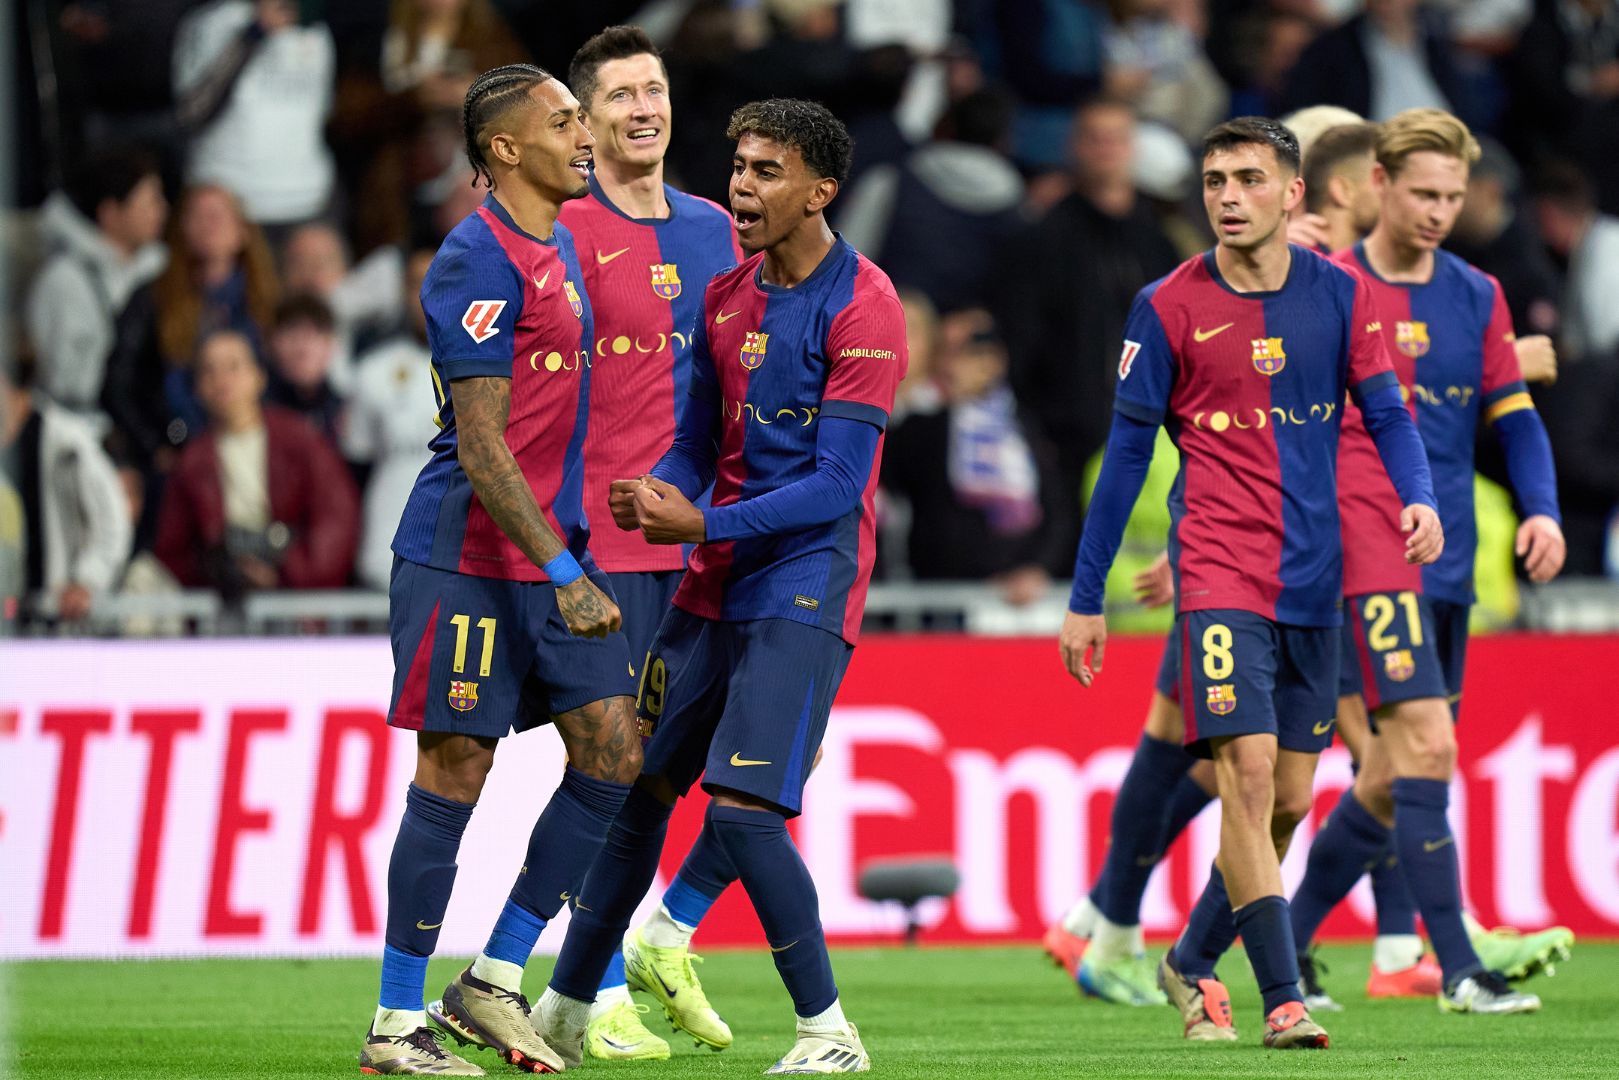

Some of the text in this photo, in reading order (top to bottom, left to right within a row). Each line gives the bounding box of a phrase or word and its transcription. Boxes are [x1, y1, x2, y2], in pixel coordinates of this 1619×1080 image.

[449, 613, 497, 677] 11
[1201, 623, 1235, 681] 8
[1363, 590, 1424, 652] 21
[0, 710, 392, 938] TTER
